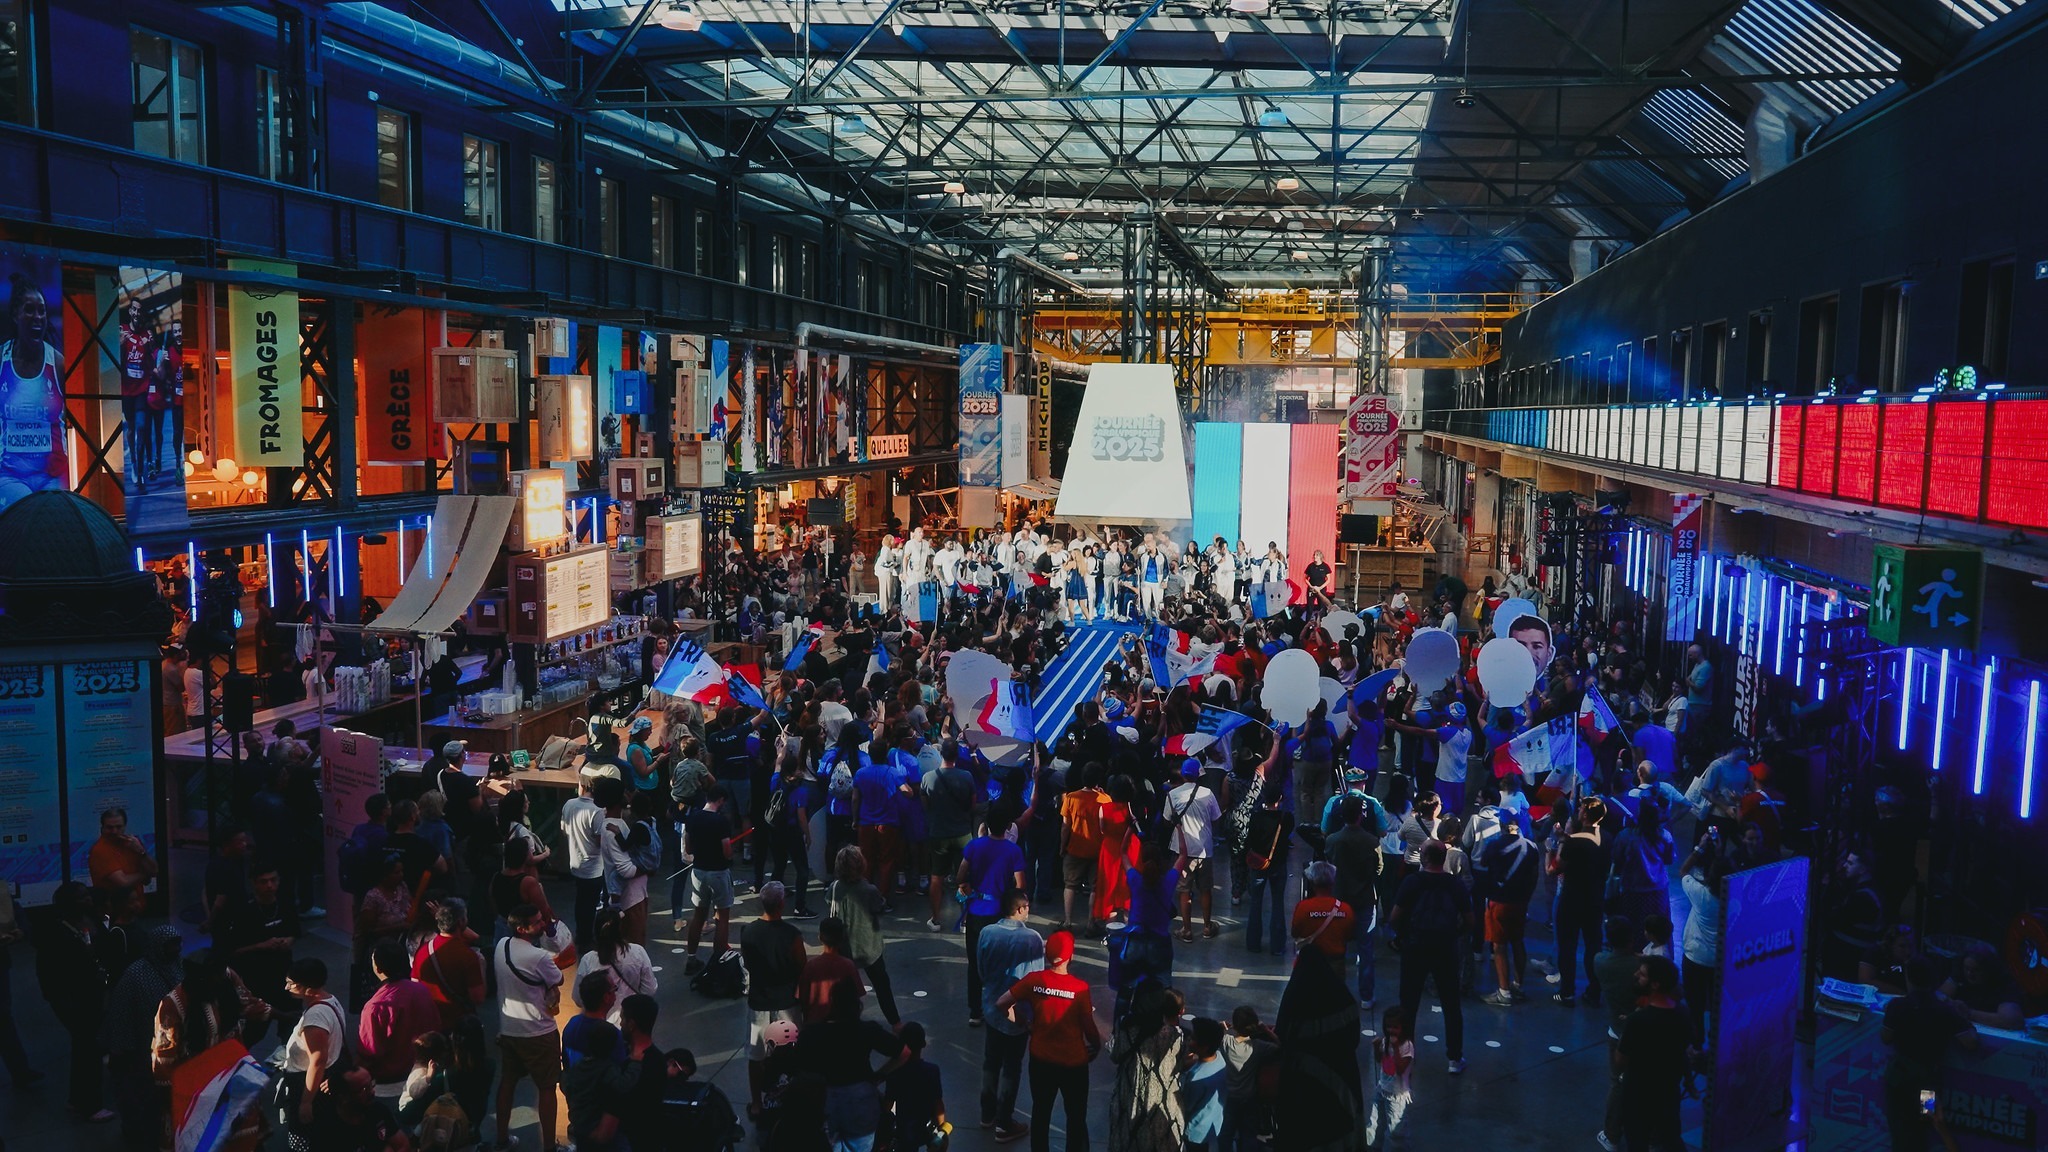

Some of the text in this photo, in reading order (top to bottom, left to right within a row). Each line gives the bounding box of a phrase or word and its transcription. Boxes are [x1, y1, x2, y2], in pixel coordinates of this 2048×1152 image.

[257, 310, 281, 455] FROMAGES
[963, 389, 997, 398] JOURNÉE
[386, 368, 411, 450] GRÈCE
[962, 402, 998, 414] 2025
[1039, 361, 1050, 451] BOLIVIE
[1093, 413, 1161, 429] JOURNÉE
[1357, 412, 1388, 420] JOURNÉE
[15, 422, 42, 430] TOYOTA
[1357, 422, 1389, 433] 2025
[871, 438, 908, 456] QUILLES
[1092, 436, 1162, 460] 2025
[1675, 551, 1687, 599] JOURNÉE
[74, 674, 138, 695] 2025
[1732, 928, 1794, 965] ACCUEIL
[1033, 985, 1076, 999] VOLONTAIRE
